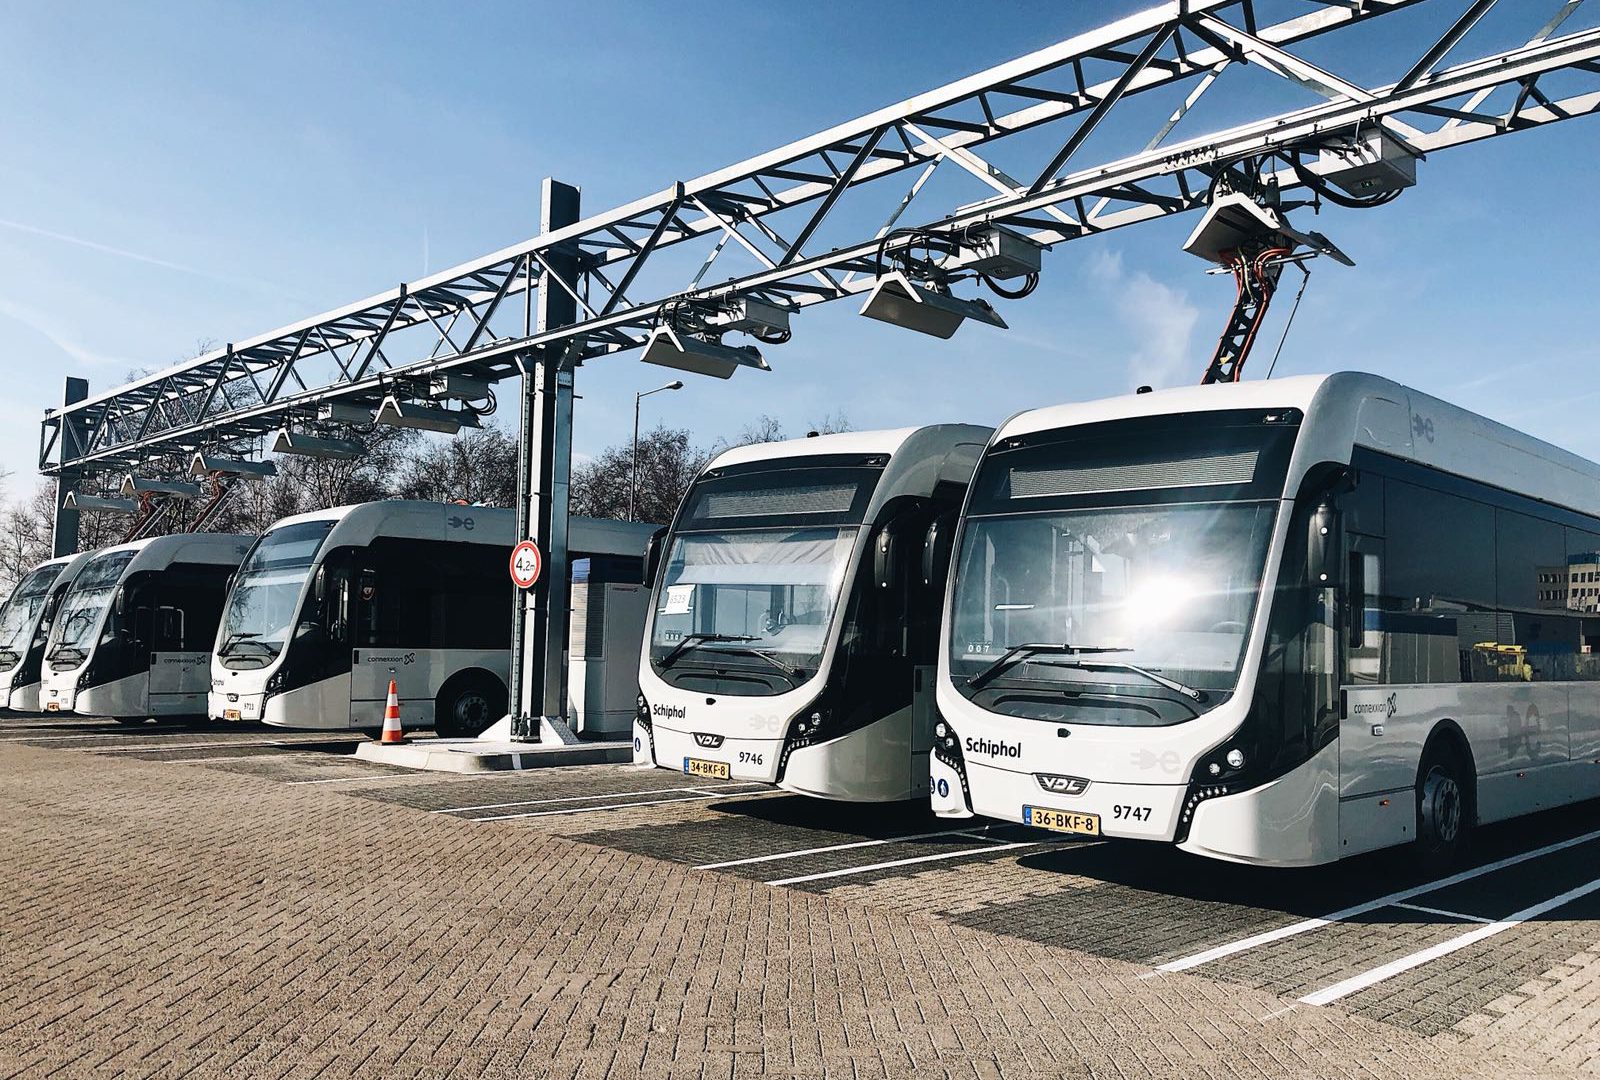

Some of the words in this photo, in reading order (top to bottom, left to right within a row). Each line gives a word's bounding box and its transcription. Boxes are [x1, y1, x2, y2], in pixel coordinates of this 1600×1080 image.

[653, 704, 686, 719] Schiphol
[1353, 703, 1387, 714] connexxion
[696, 735, 720, 746] VDL
[966, 737, 1021, 758] Schiphol
[739, 751, 763, 765] 9746
[691, 761, 726, 776] 34-BKF-8
[1042, 776, 1081, 792] VDL
[1113, 804, 1152, 821] 9747
[1035, 811, 1093, 831] 36-BKF-8
